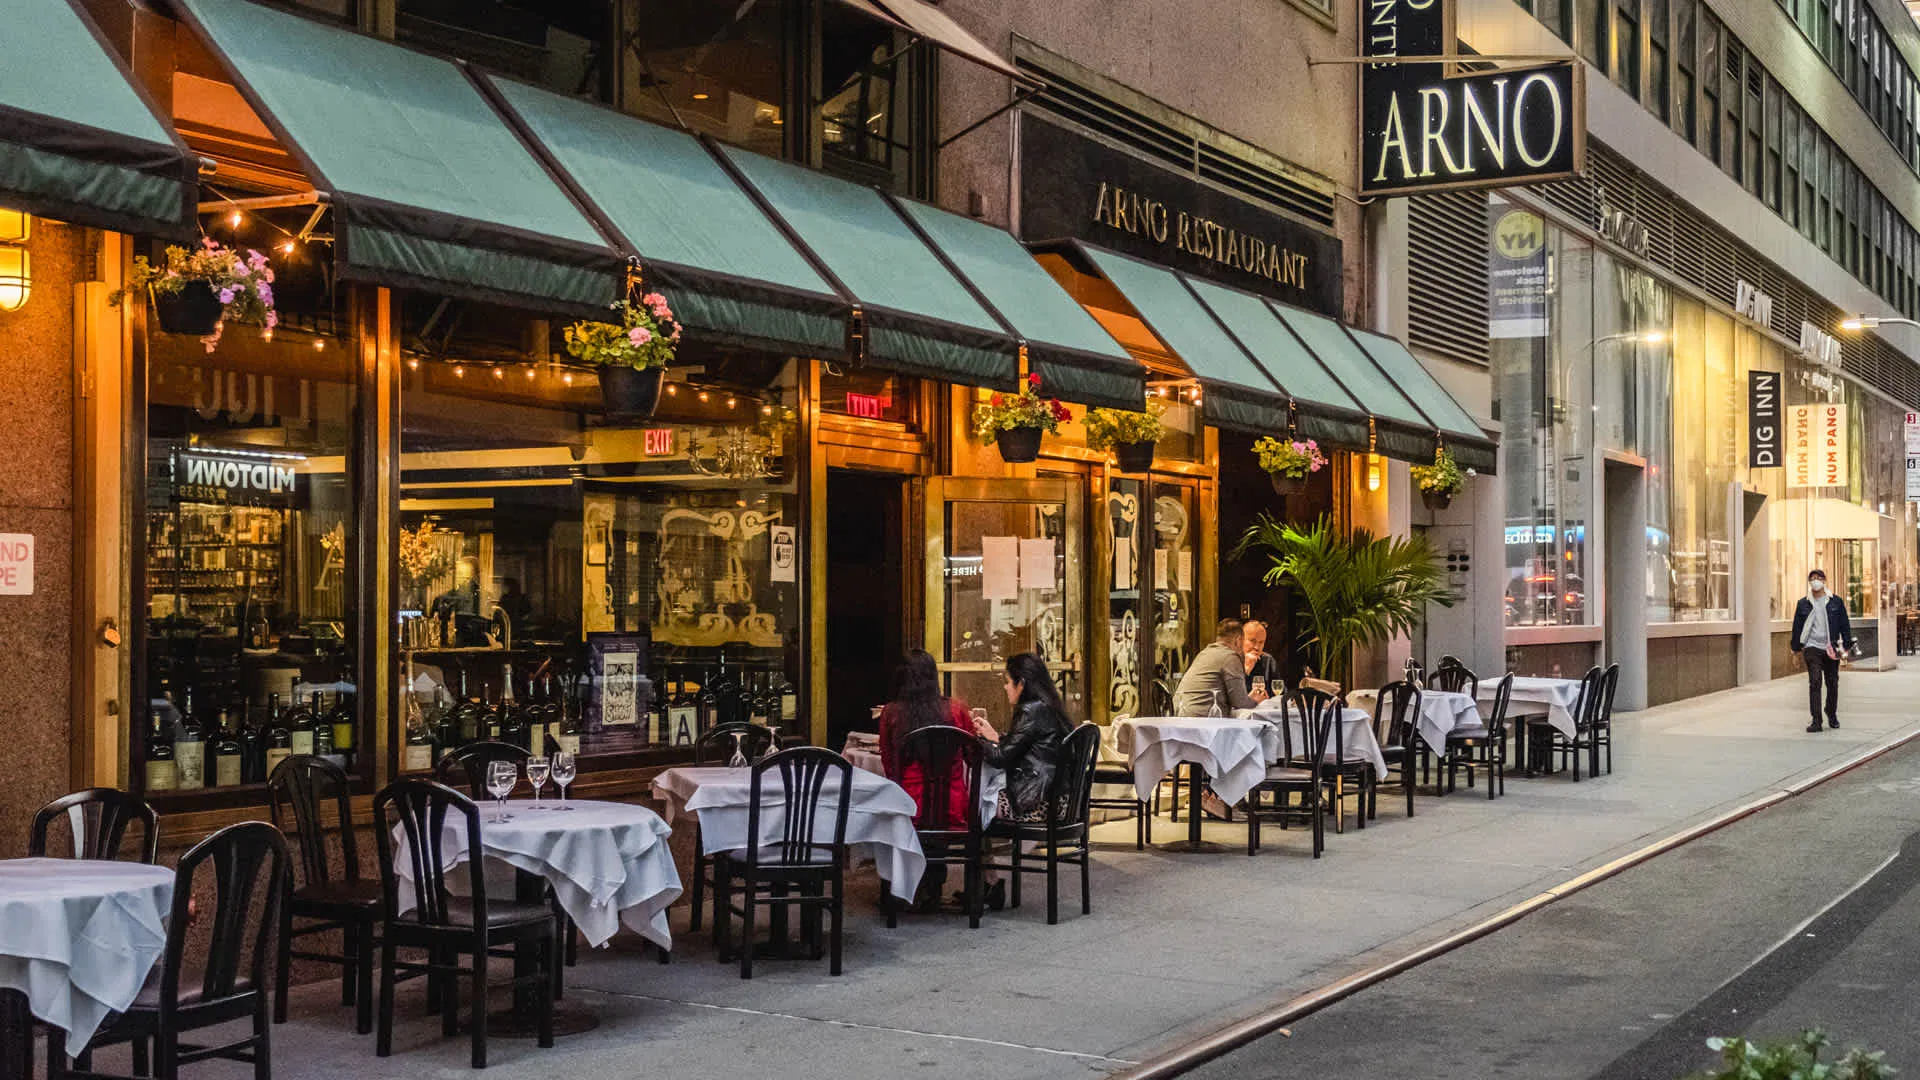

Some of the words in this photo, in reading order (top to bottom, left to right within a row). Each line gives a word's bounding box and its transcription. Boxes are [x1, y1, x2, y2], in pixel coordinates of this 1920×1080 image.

[1372, 73, 1562, 182] ARNO
[1092, 181, 1169, 244] ARNO
[1176, 210, 1309, 290] RESTAURANT
[1756, 375, 1773, 417] INN
[645, 428, 673, 455] EXIT
[1756, 425, 1774, 465] DIG
[1826, 407, 1837, 447] PANG
[1826, 451, 1837, 484] NUM
[675, 713, 693, 745] A
